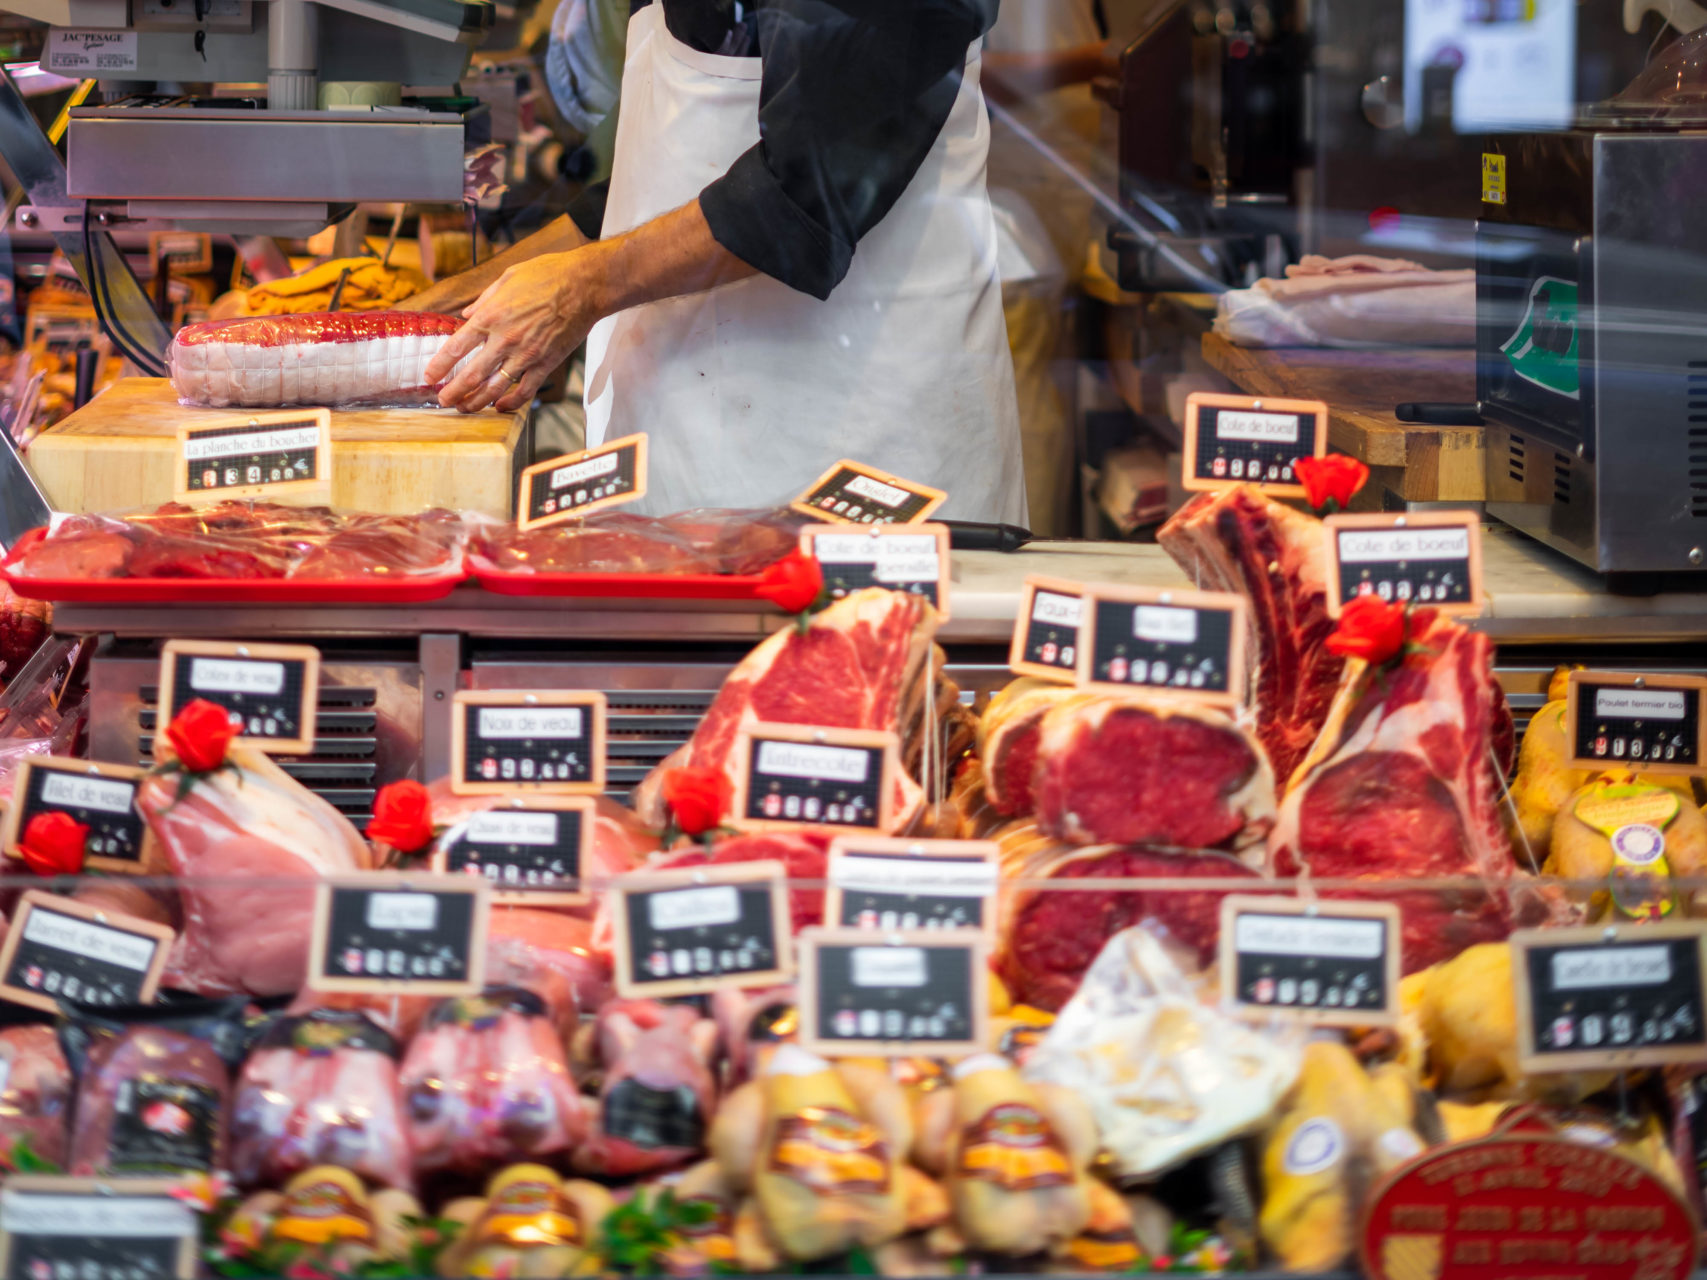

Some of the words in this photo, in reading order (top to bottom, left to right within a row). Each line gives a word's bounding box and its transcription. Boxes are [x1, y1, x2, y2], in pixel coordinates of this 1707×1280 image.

[1248, 420, 1262, 432] de
[203, 439, 248, 456] planche
[251, 436, 266, 449] du
[270, 431, 317, 447] boucher
[1389, 536, 1413, 552] de
[1417, 534, 1466, 551] boeuf
[1599, 698, 1629, 708] Poulet
[1632, 699, 1665, 709] fermier
[1668, 701, 1684, 710] bio
